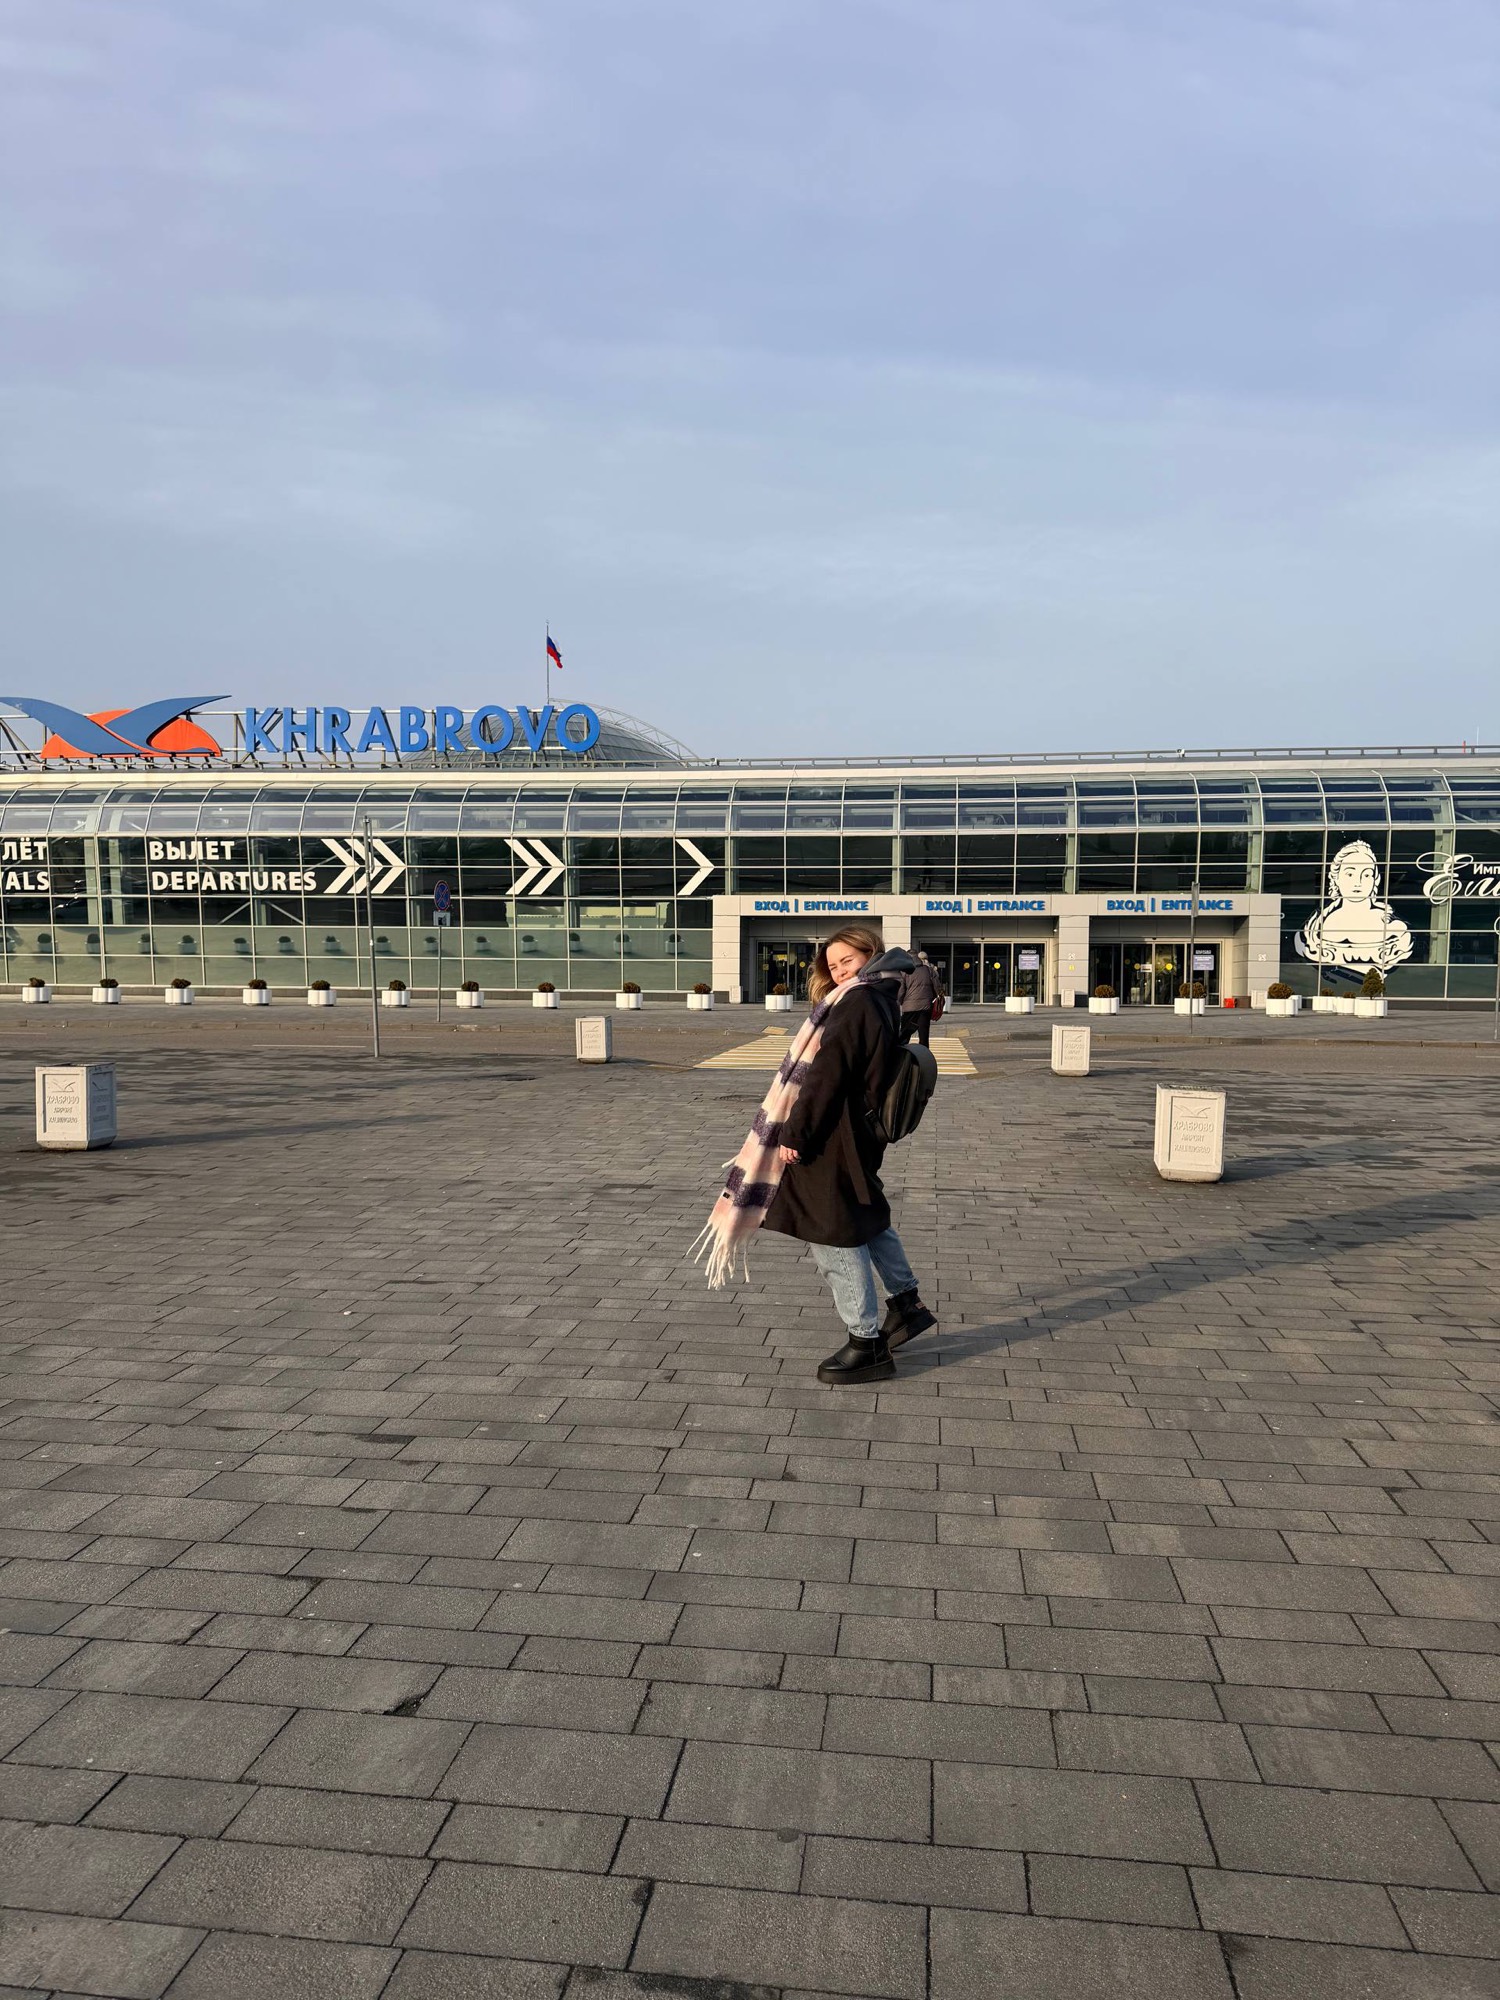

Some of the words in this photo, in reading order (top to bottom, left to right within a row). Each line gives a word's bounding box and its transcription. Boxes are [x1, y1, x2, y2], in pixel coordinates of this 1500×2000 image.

[245, 704, 601, 753] KHRABROVO
[149, 840, 235, 861] ВЫЛЕТ
[0, 871, 50, 891] ALS
[152, 870, 317, 892] DEPARTURES
[754, 900, 790, 912] ВХОД
[803, 900, 869, 911] ENTRANCE
[926, 900, 962, 913] ВХОД
[977, 900, 1045, 911] ENTRANCE
[1106, 900, 1145, 912] ВХОД
